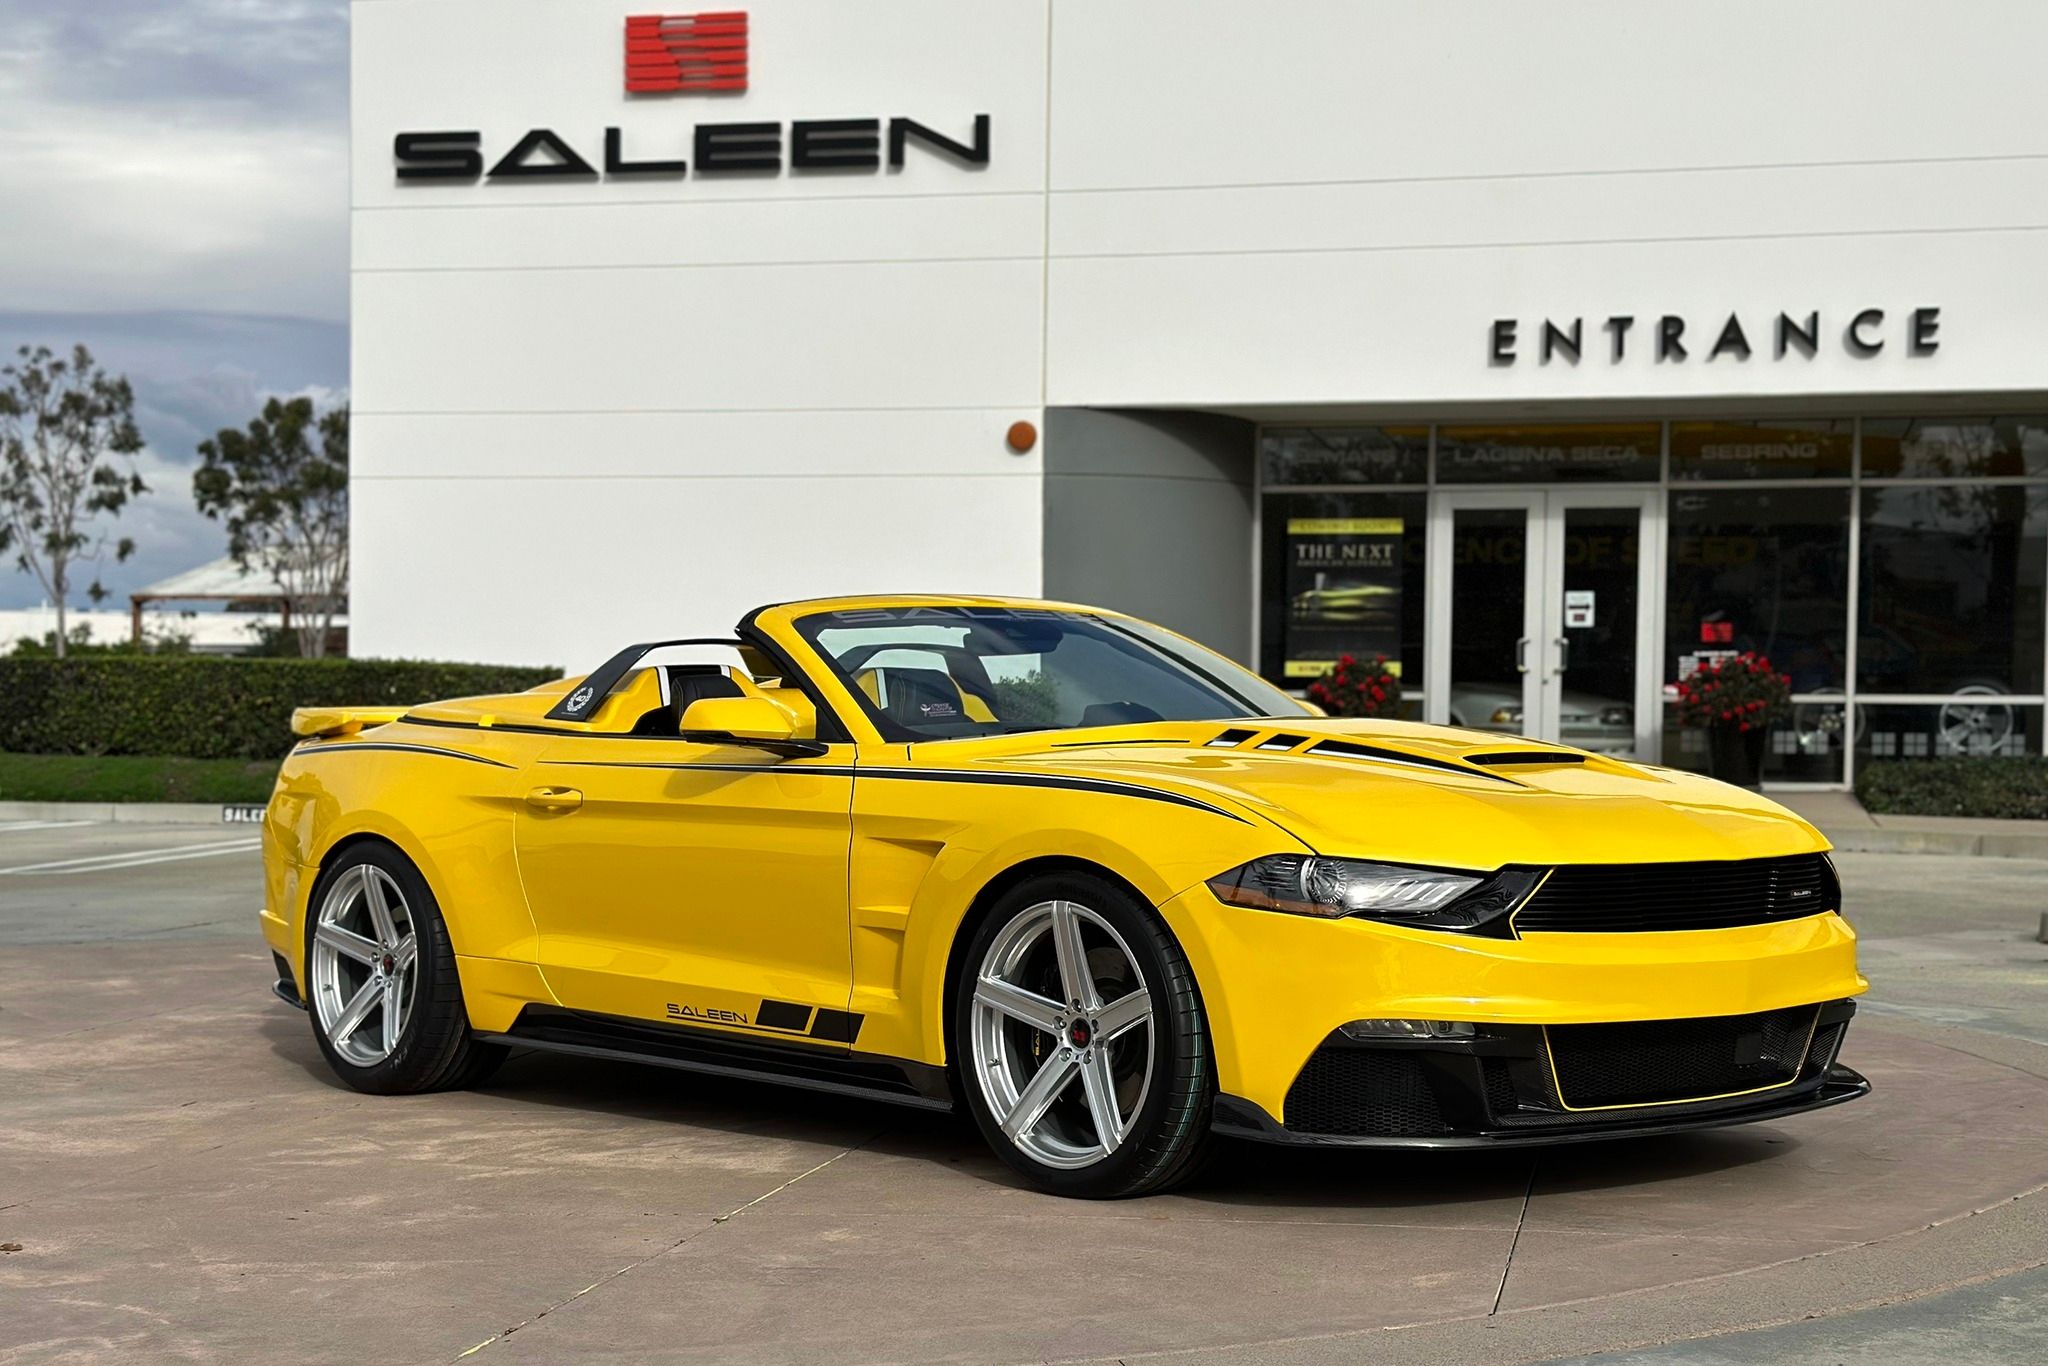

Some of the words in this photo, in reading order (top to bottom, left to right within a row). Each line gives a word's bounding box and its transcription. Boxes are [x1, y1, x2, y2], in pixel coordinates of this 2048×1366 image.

[394, 114, 990, 182] SALEEN
[1491, 307, 1941, 366] ENTRANCE
[1453, 444, 1565, 463] LAGUNA
[1571, 445, 1640, 462] SECA
[1701, 443, 1819, 460] SEBRING
[1296, 544, 1334, 559] THE
[1341, 543, 1395, 559] NEXT
[667, 1003, 748, 1024] SALEEN
